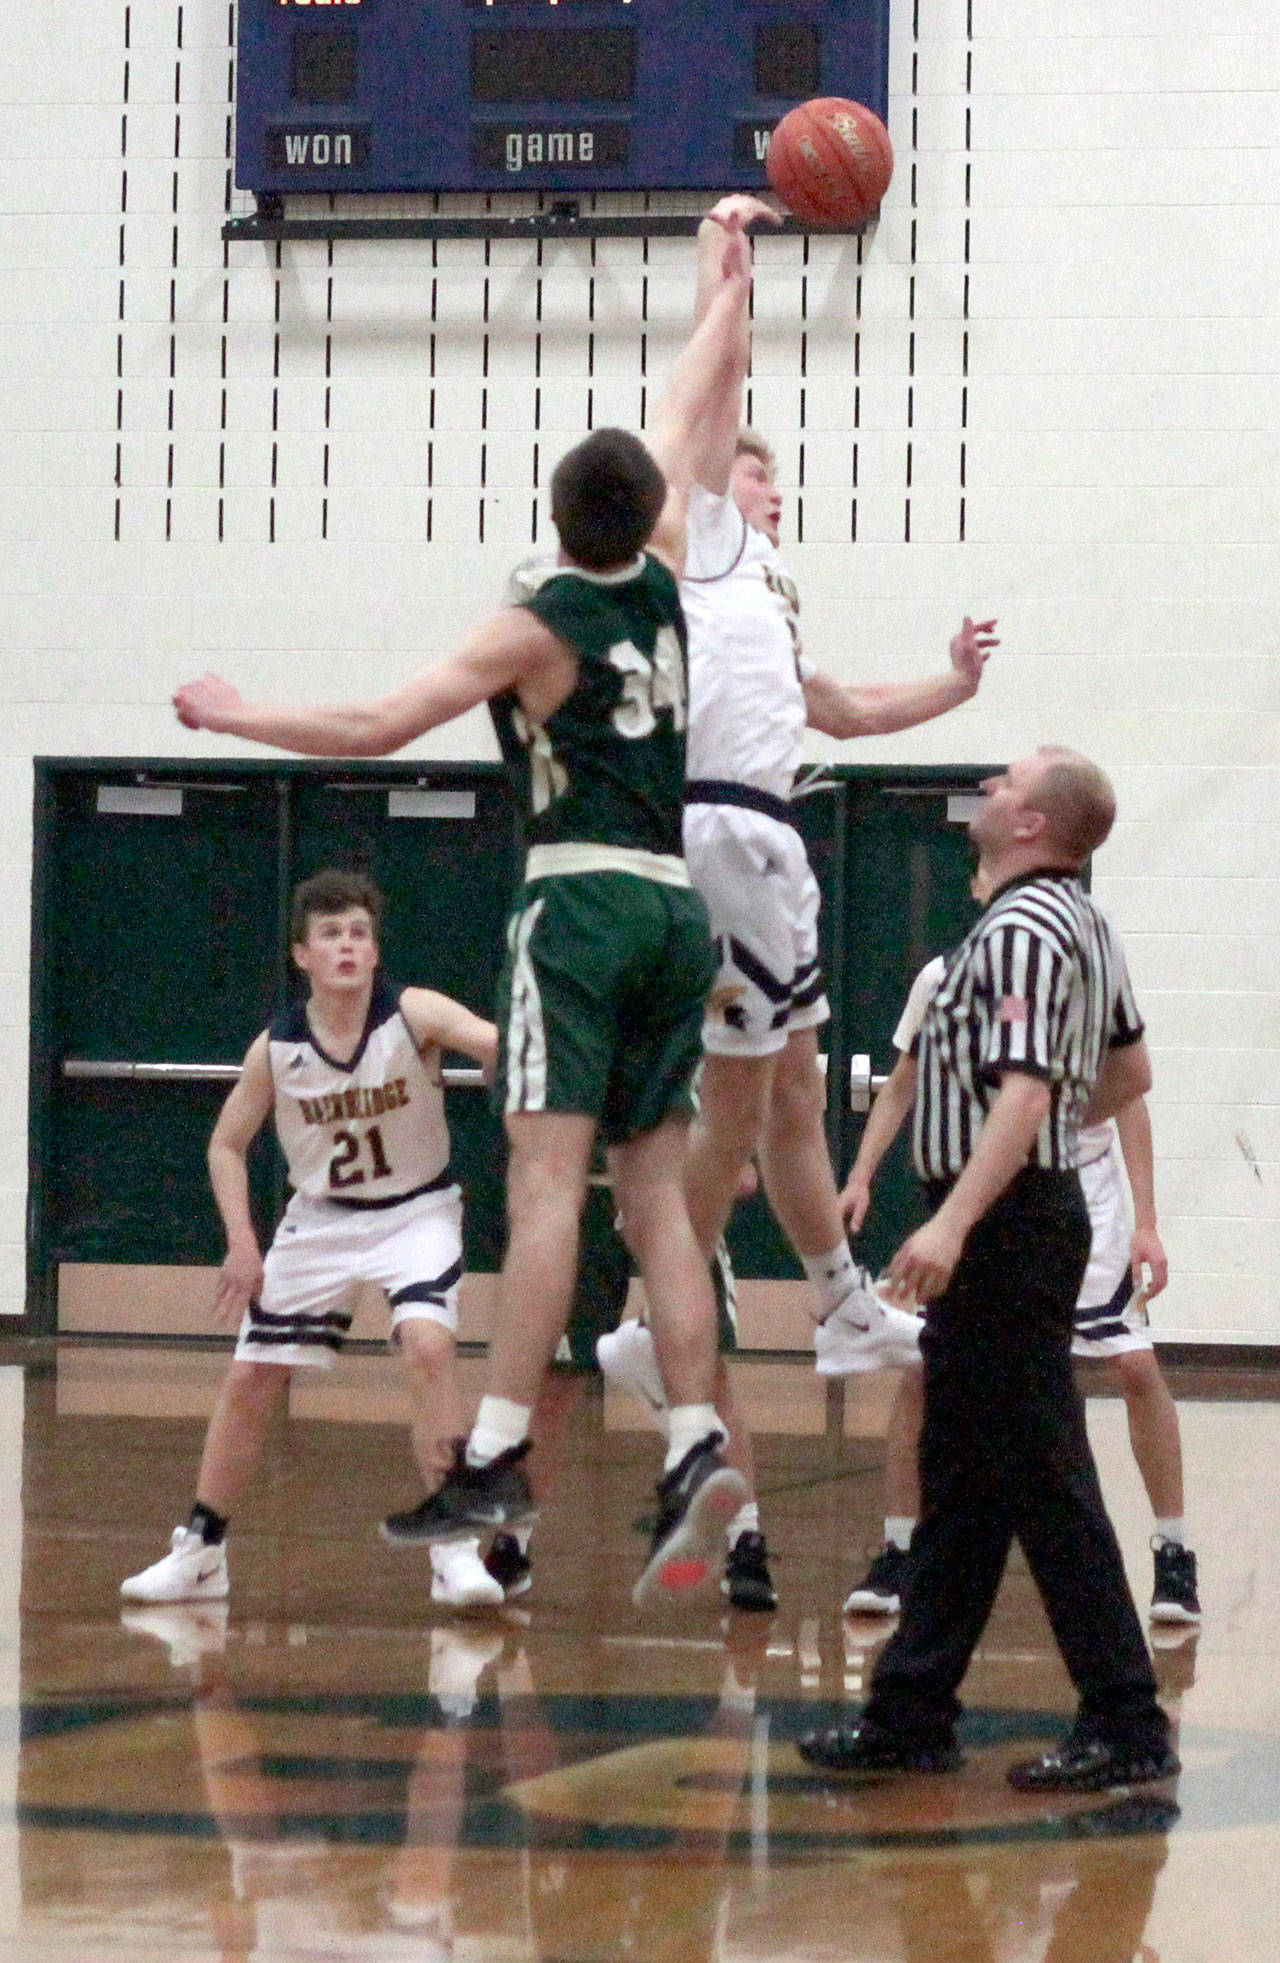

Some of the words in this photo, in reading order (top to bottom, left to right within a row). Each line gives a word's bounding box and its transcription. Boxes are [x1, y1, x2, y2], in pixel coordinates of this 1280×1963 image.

[285, 134, 352, 165] won
[505, 132, 594, 172] game
[608, 624, 687, 740] 34
[329, 1124, 393, 1188] 21
